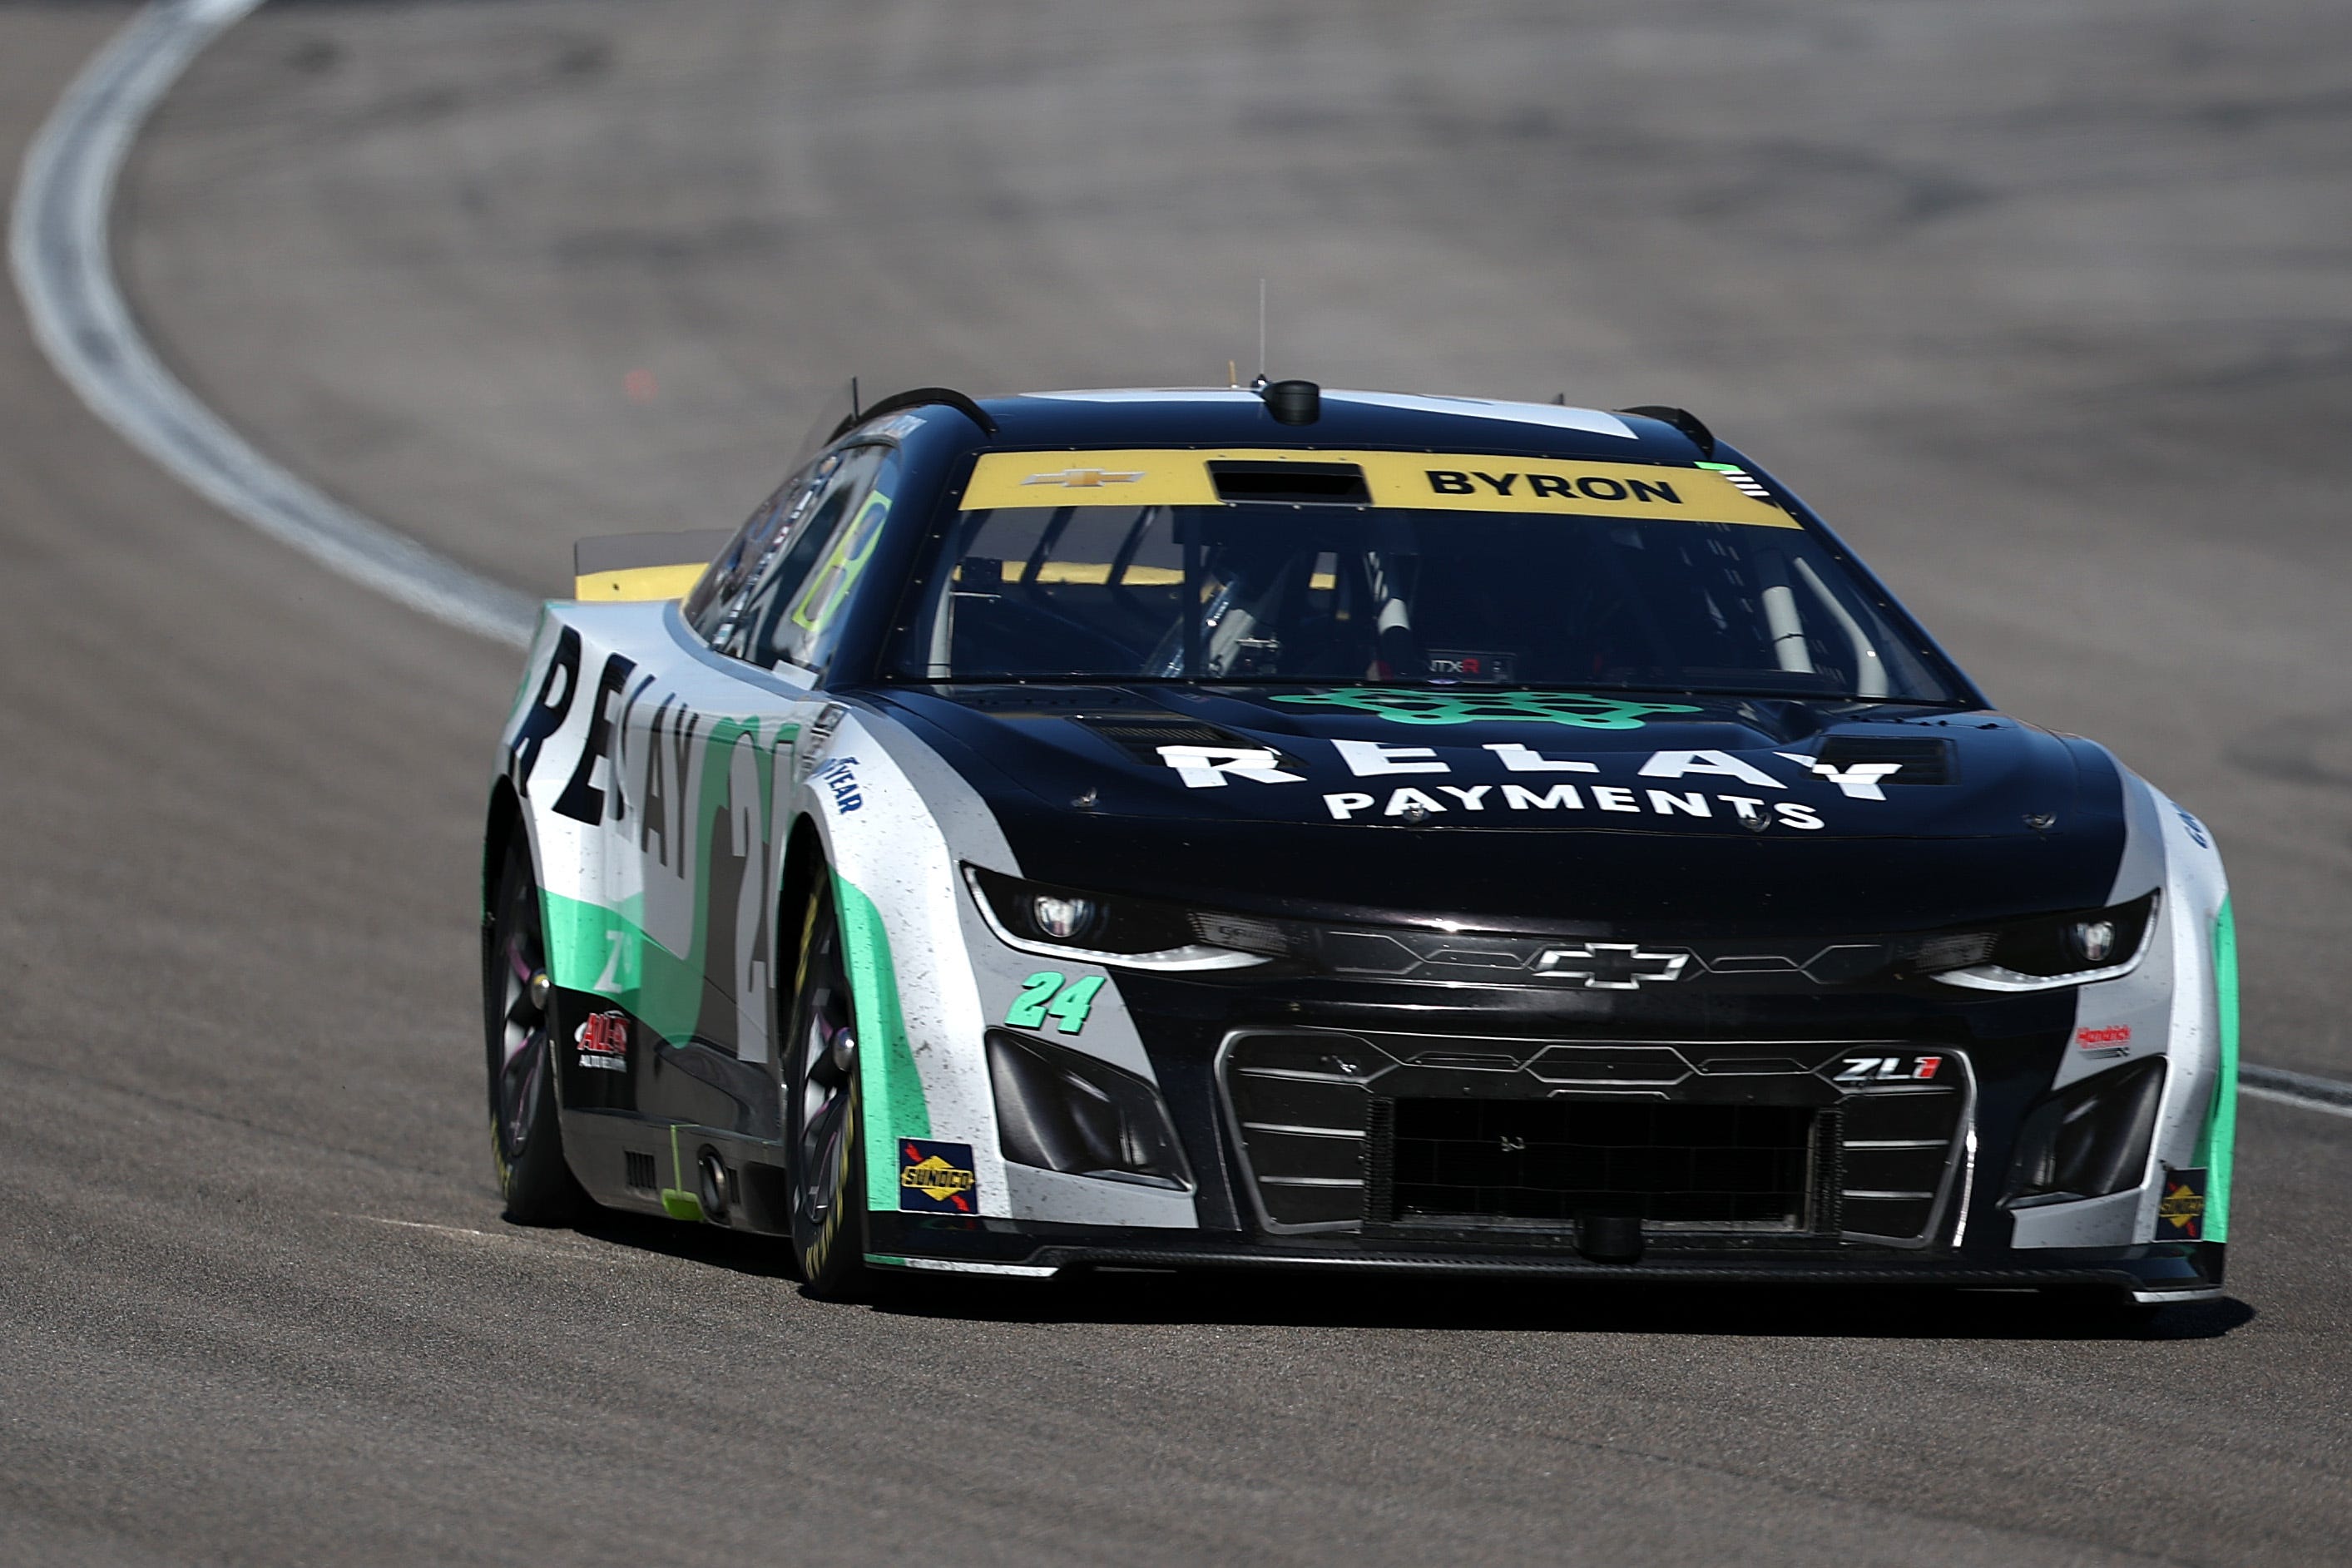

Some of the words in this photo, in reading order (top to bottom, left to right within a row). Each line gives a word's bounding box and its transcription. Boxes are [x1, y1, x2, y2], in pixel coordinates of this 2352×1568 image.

[1424, 469, 1684, 505] BYRON
[1156, 739, 1904, 801] RELAY
[1322, 784, 1825, 830] PAYMENTS
[1004, 971, 1107, 1034] 24
[1833, 1056, 1943, 1081] ZL1
